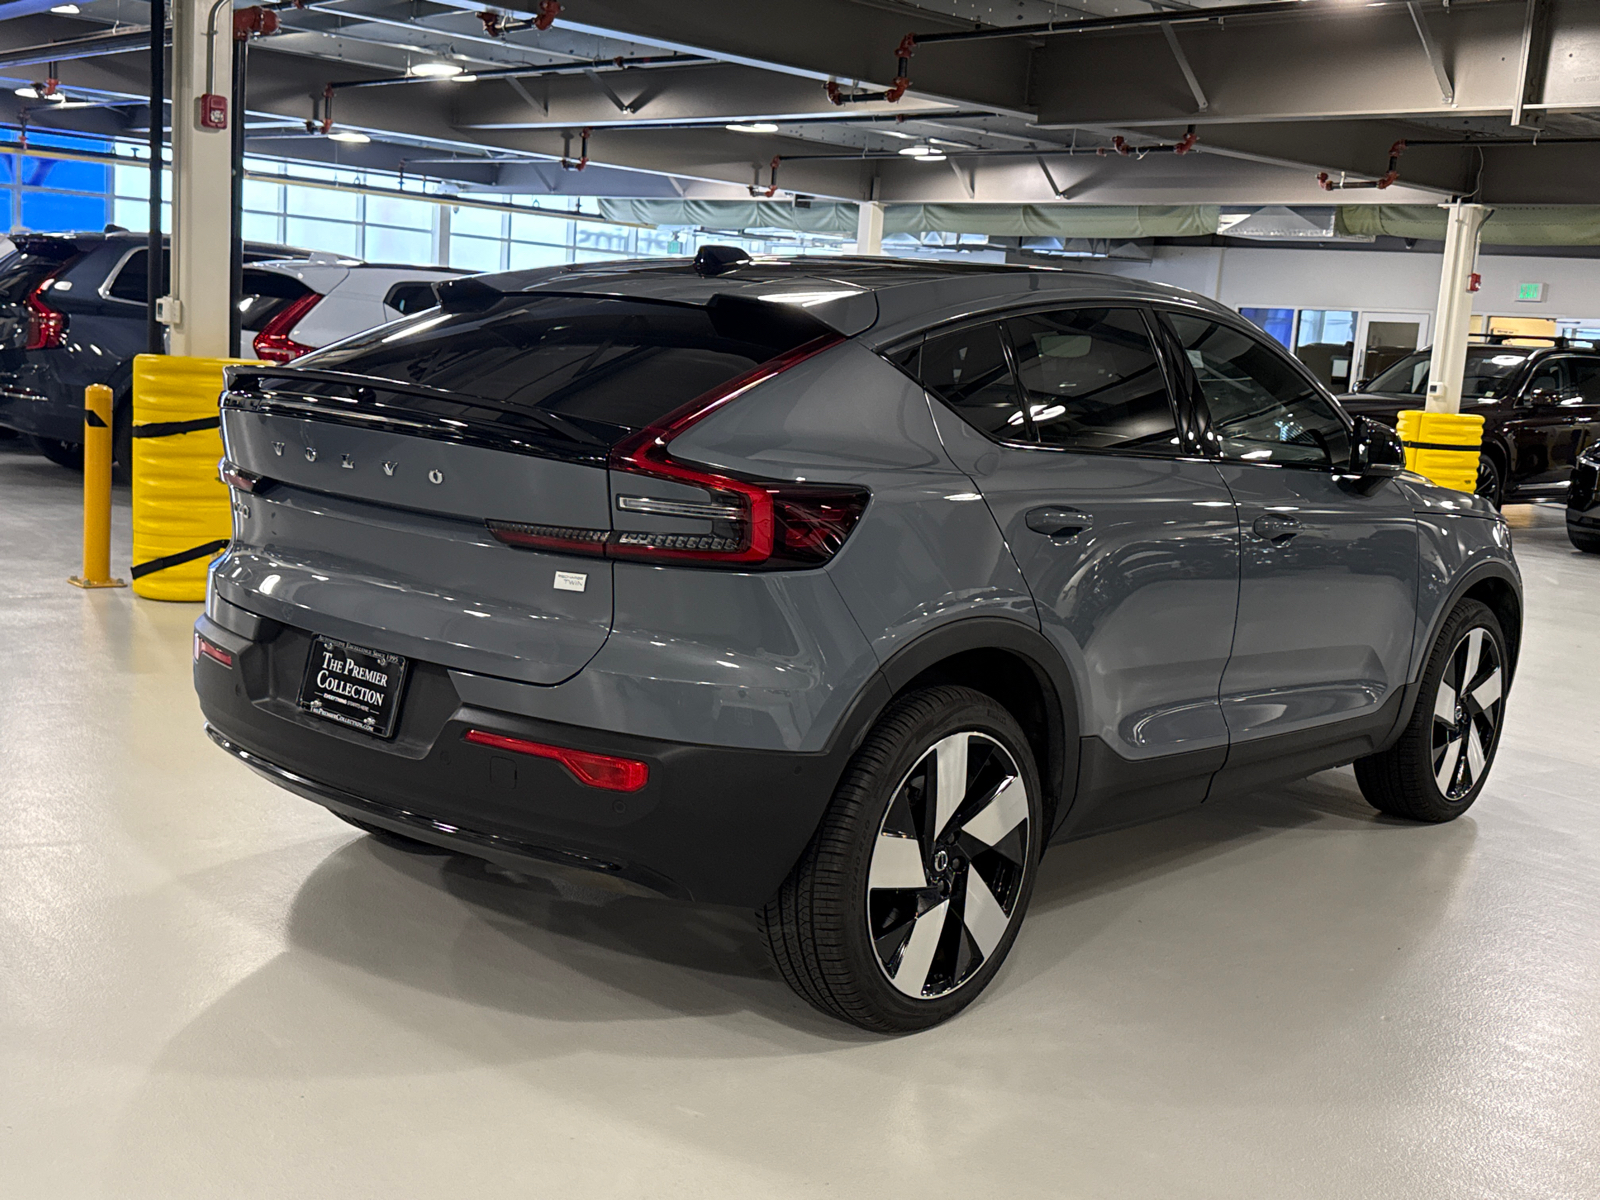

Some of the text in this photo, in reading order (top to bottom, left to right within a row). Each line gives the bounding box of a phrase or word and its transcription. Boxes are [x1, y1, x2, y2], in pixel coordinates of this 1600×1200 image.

[271, 441, 444, 485] VOLVO
[317, 669, 385, 707] COLLECTION
[323, 651, 388, 687] THE PREMIER
